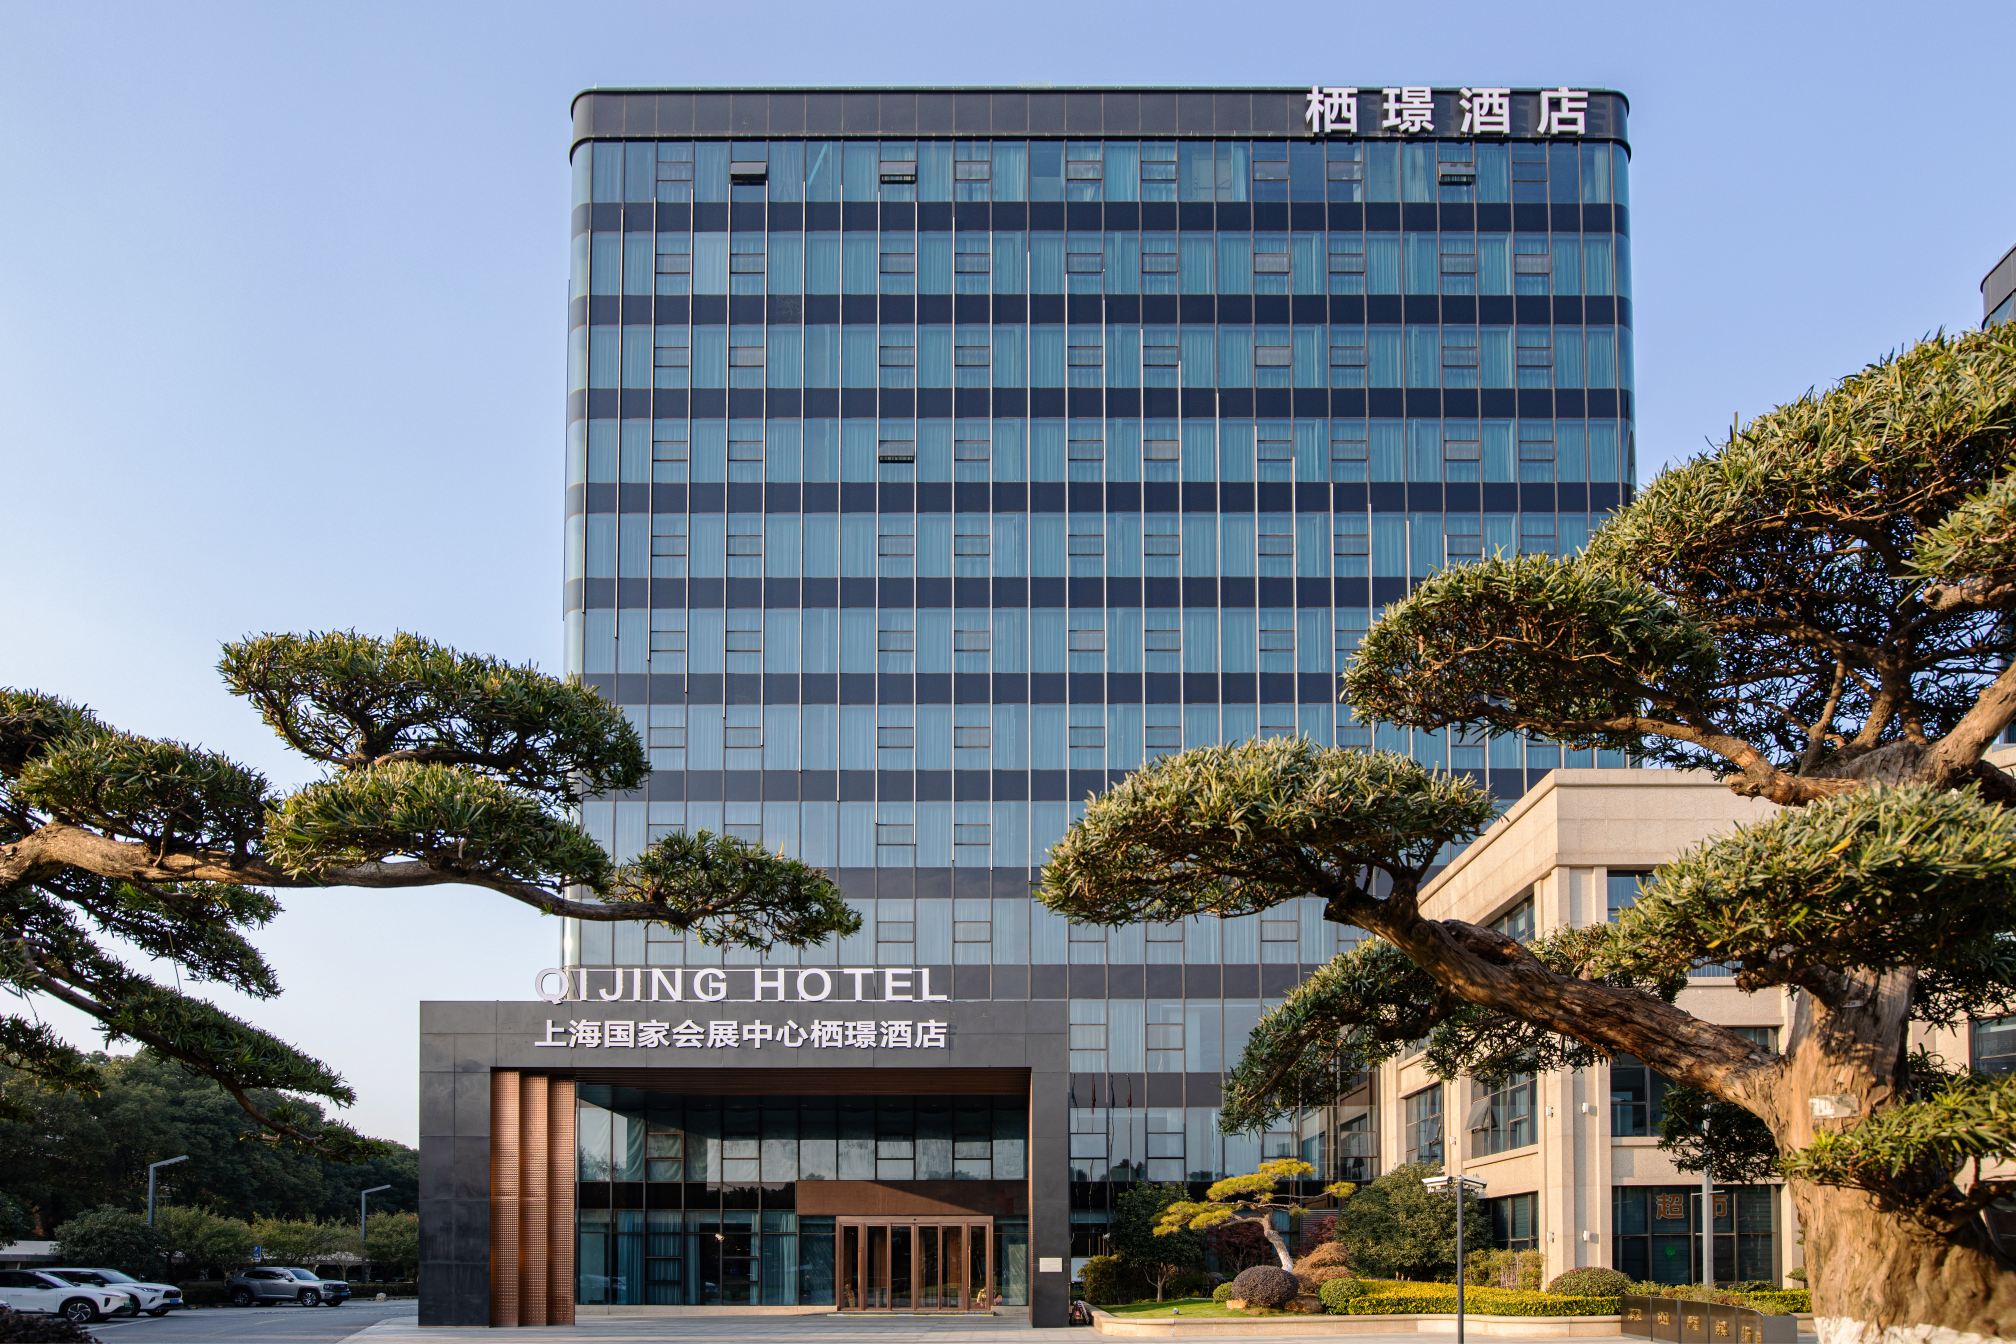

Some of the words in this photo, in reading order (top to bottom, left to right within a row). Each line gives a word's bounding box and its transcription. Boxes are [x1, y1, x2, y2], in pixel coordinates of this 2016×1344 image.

[1305, 85, 1589, 136] 栖璟酒店
[535, 967, 727, 1004] QIJING
[755, 967, 947, 1002] HOTEL
[534, 1019, 948, 1048] 上海国家会展中心栖璟酒店
